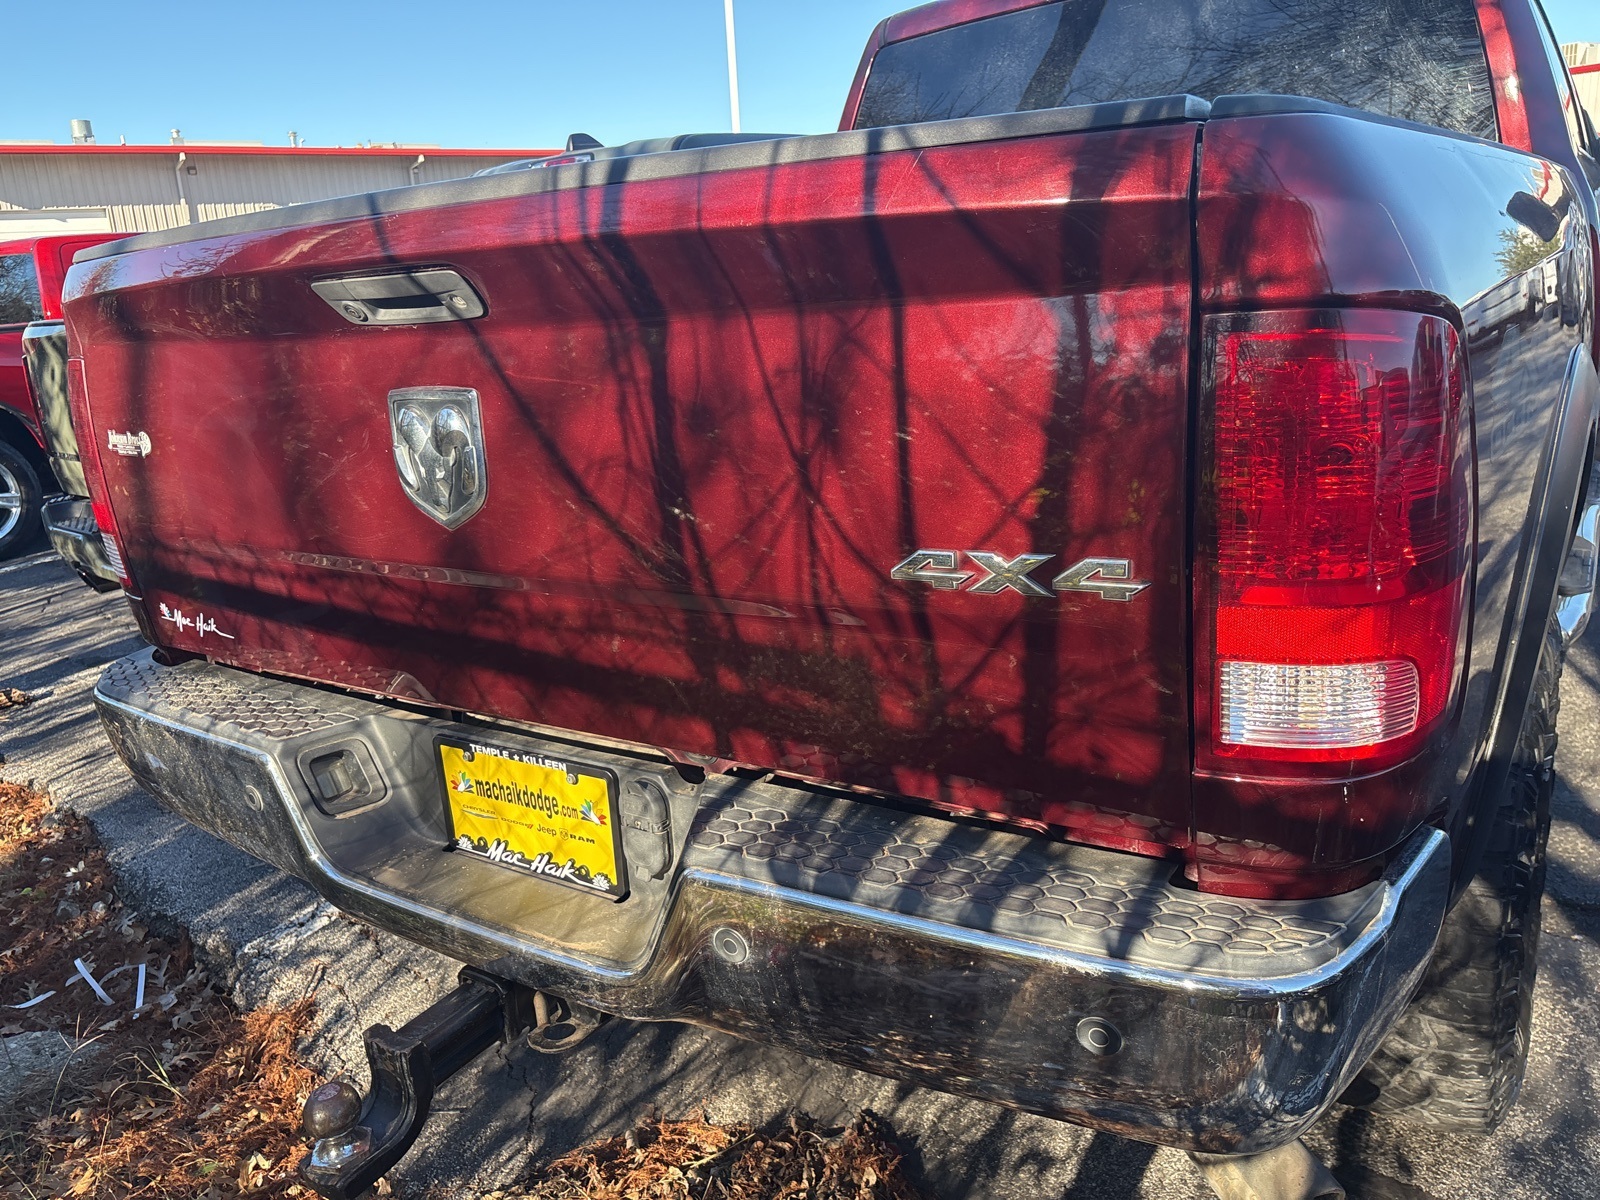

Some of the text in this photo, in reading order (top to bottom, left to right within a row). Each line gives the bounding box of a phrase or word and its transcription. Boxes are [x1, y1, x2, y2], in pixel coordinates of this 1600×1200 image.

[173, 608, 222, 637] Mac Haik
[469, 743, 567, 771] TEMPLE KILLEEN
[474, 778, 579, 819] machaikdodge.com
[462, 804, 496, 815] CHRYSLER
[501, 817, 529, 829] DODGE
[536, 825, 557, 837] Jeep
[569, 833, 595, 845] RAM
[486, 840, 580, 879] Mac Haik
